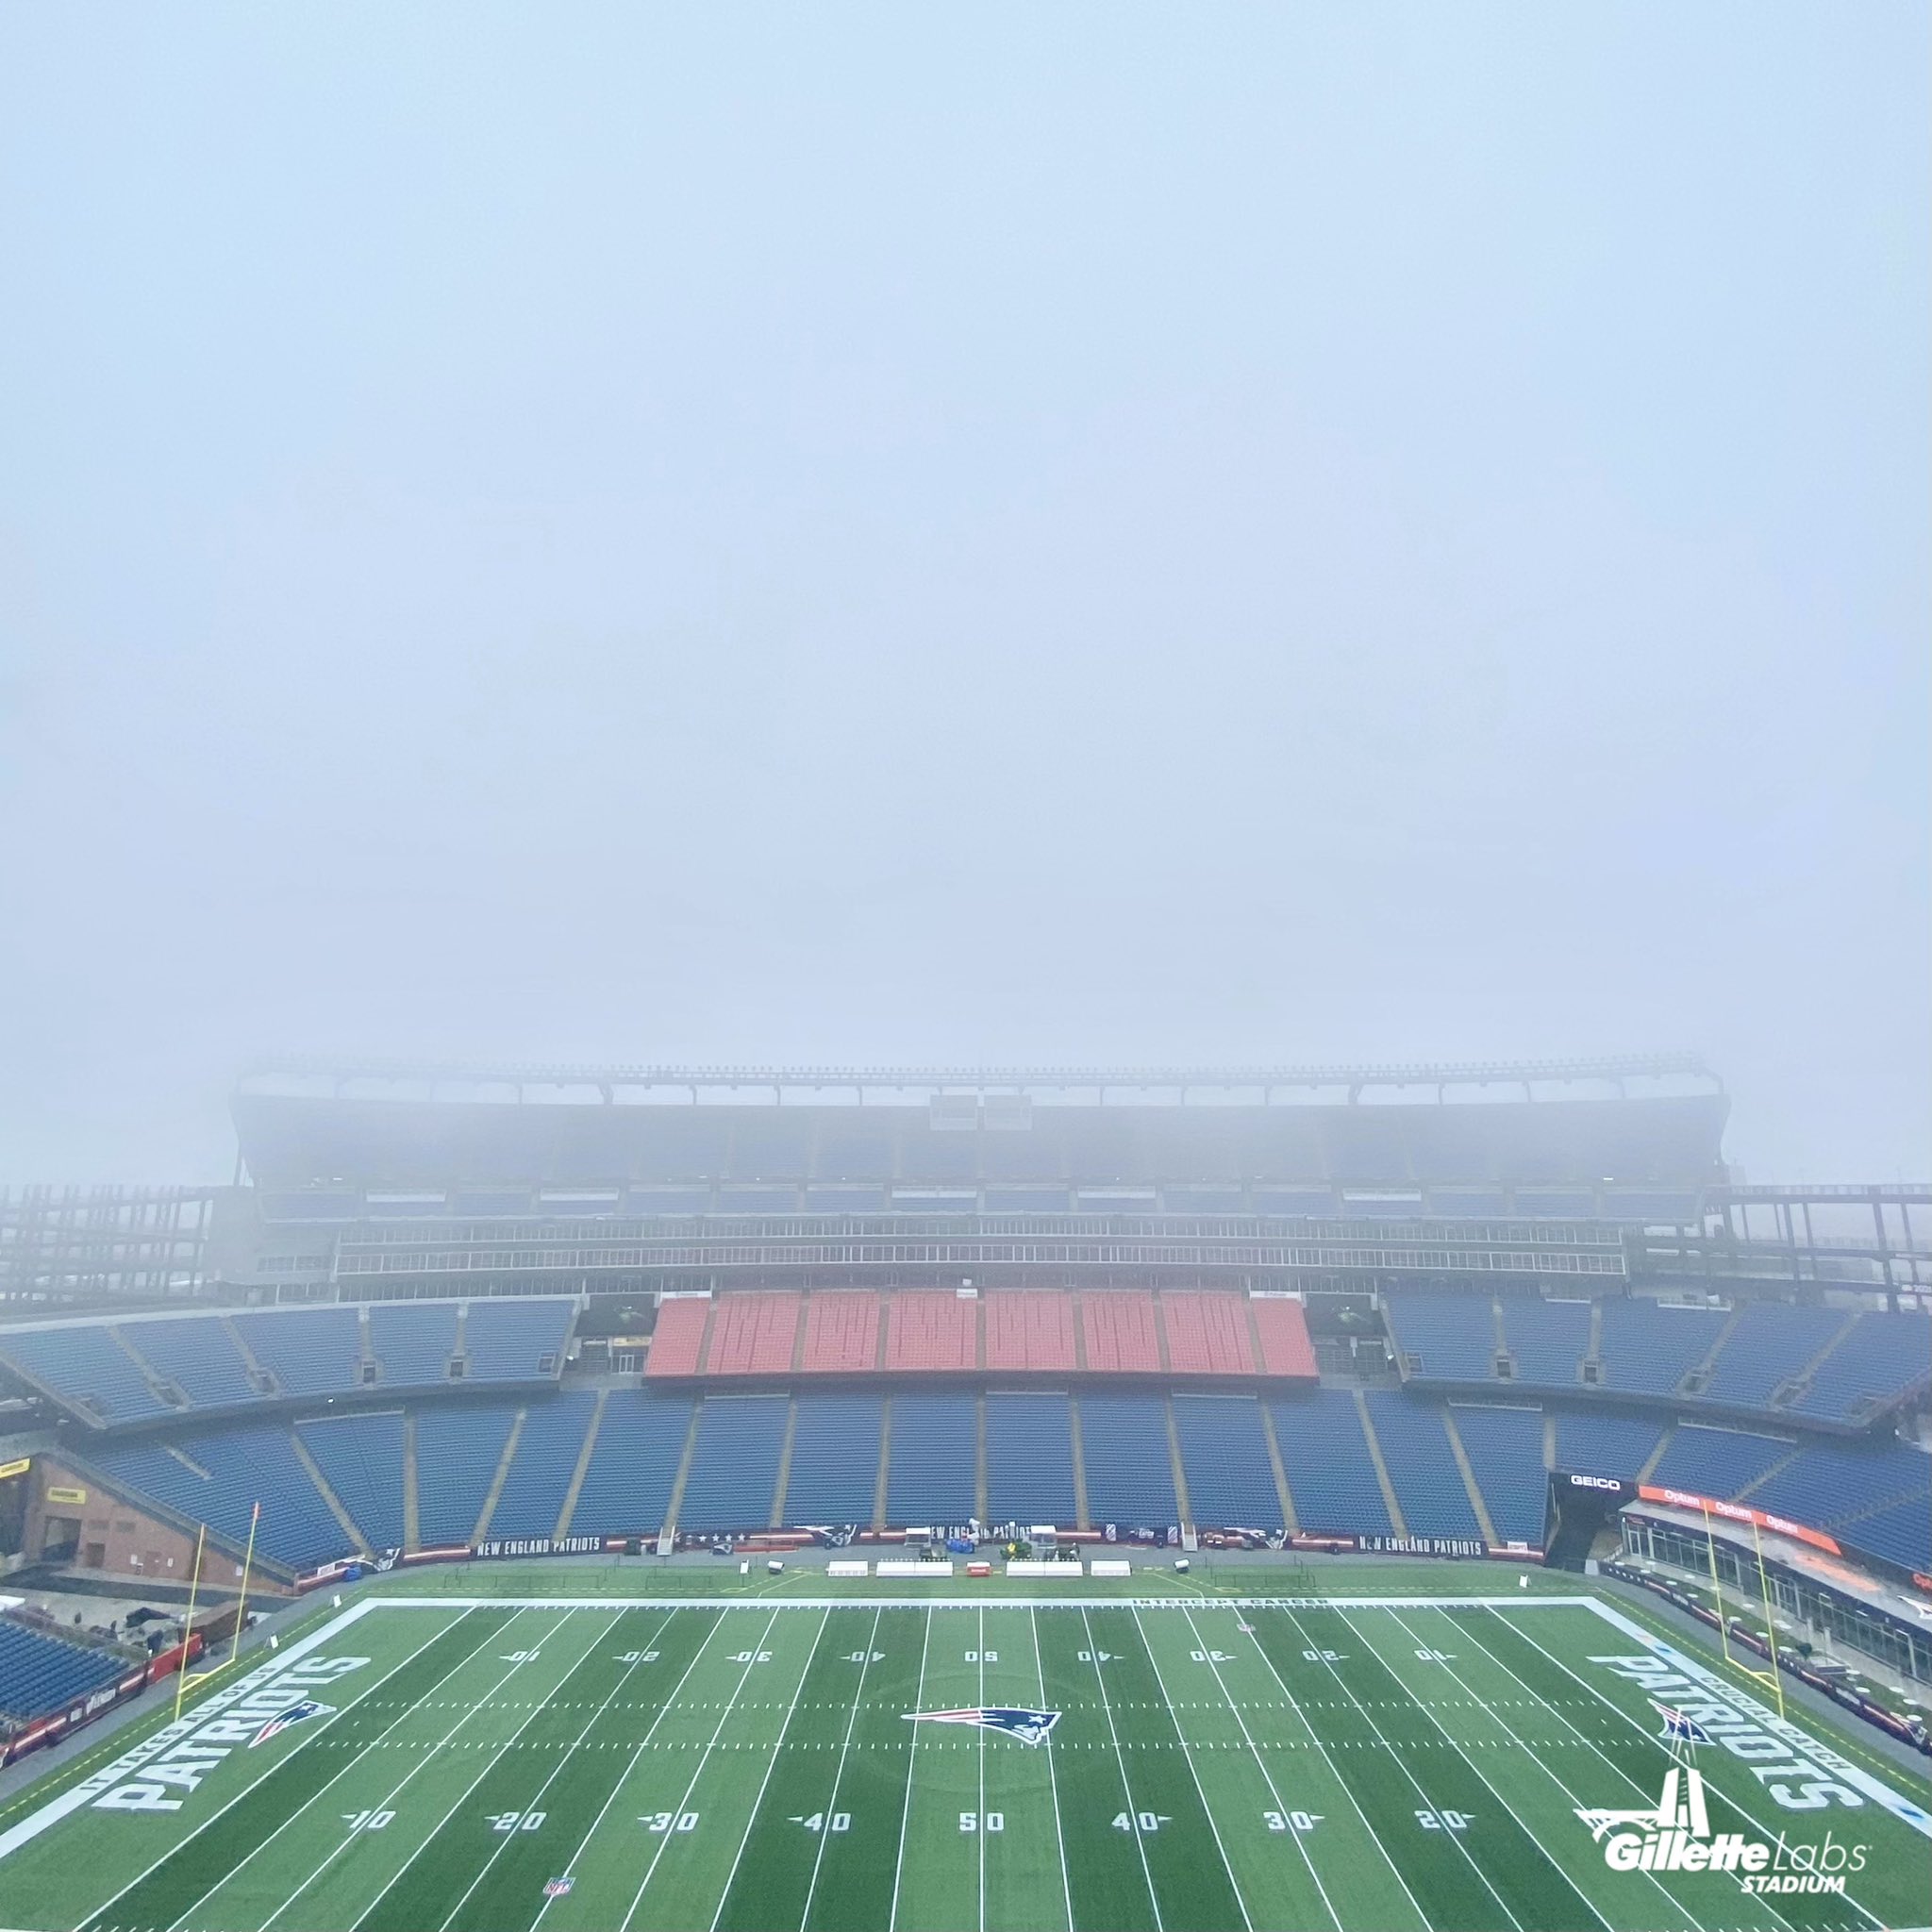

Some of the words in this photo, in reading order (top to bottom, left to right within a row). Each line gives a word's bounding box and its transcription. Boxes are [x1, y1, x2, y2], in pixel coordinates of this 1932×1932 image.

[1570, 1474, 1621, 1491] GEICO
[1664, 1489, 1700, 1507] Optum
[1715, 1501, 1752, 1520] Optum
[924, 1526, 945, 1539] EW
[1765, 1515, 1799, 1534] Optum
[477, 1541, 502, 1557] NEW
[505, 1539, 549, 1555] ENGLAND
[553, 1537, 600, 1553] PATRIOTS
[1386, 1537, 1430, 1553] ENGLAND
[1434, 1540, 1481, 1555] PATRIOTS
[509, 1651, 541, 1661] 10
[623, 1651, 660, 1661] 20
[736, 1651, 773, 1661] 30
[851, 1651, 886, 1661] 40
[964, 1651, 998, 1661] 50
[1077, 1651, 1111, 1661] 40
[1190, 1651, 1226, 1661] 30
[1302, 1651, 1340, 1661] 20
[1414, 1650, 1447, 1661] 10
[80, 1777, 109, 1790] IT
[109, 1728, 184, 1771] TAKES
[183, 1701, 225, 1724] ALL
[222, 1684, 247, 1697] OF
[248, 1667, 276, 1679] US
[1586, 1656, 1864, 1808] PATRIOTS
[1700, 1676, 1778, 1724] CRUCIAL
[1779, 1728, 1852, 1770] CATCH
[92, 1657, 371, 1810] PATRIOTS
[349, 1810, 396, 1829] 10
[493, 1811, 547, 1830] 20
[649, 1812, 699, 1831] 30
[804, 1812, 851, 1831] 40
[959, 1812, 1004, 1831] 50
[1111, 1812, 1158, 1831] 40
[1263, 1811, 1313, 1830] 30
[1415, 1810, 1467, 1828] 20
